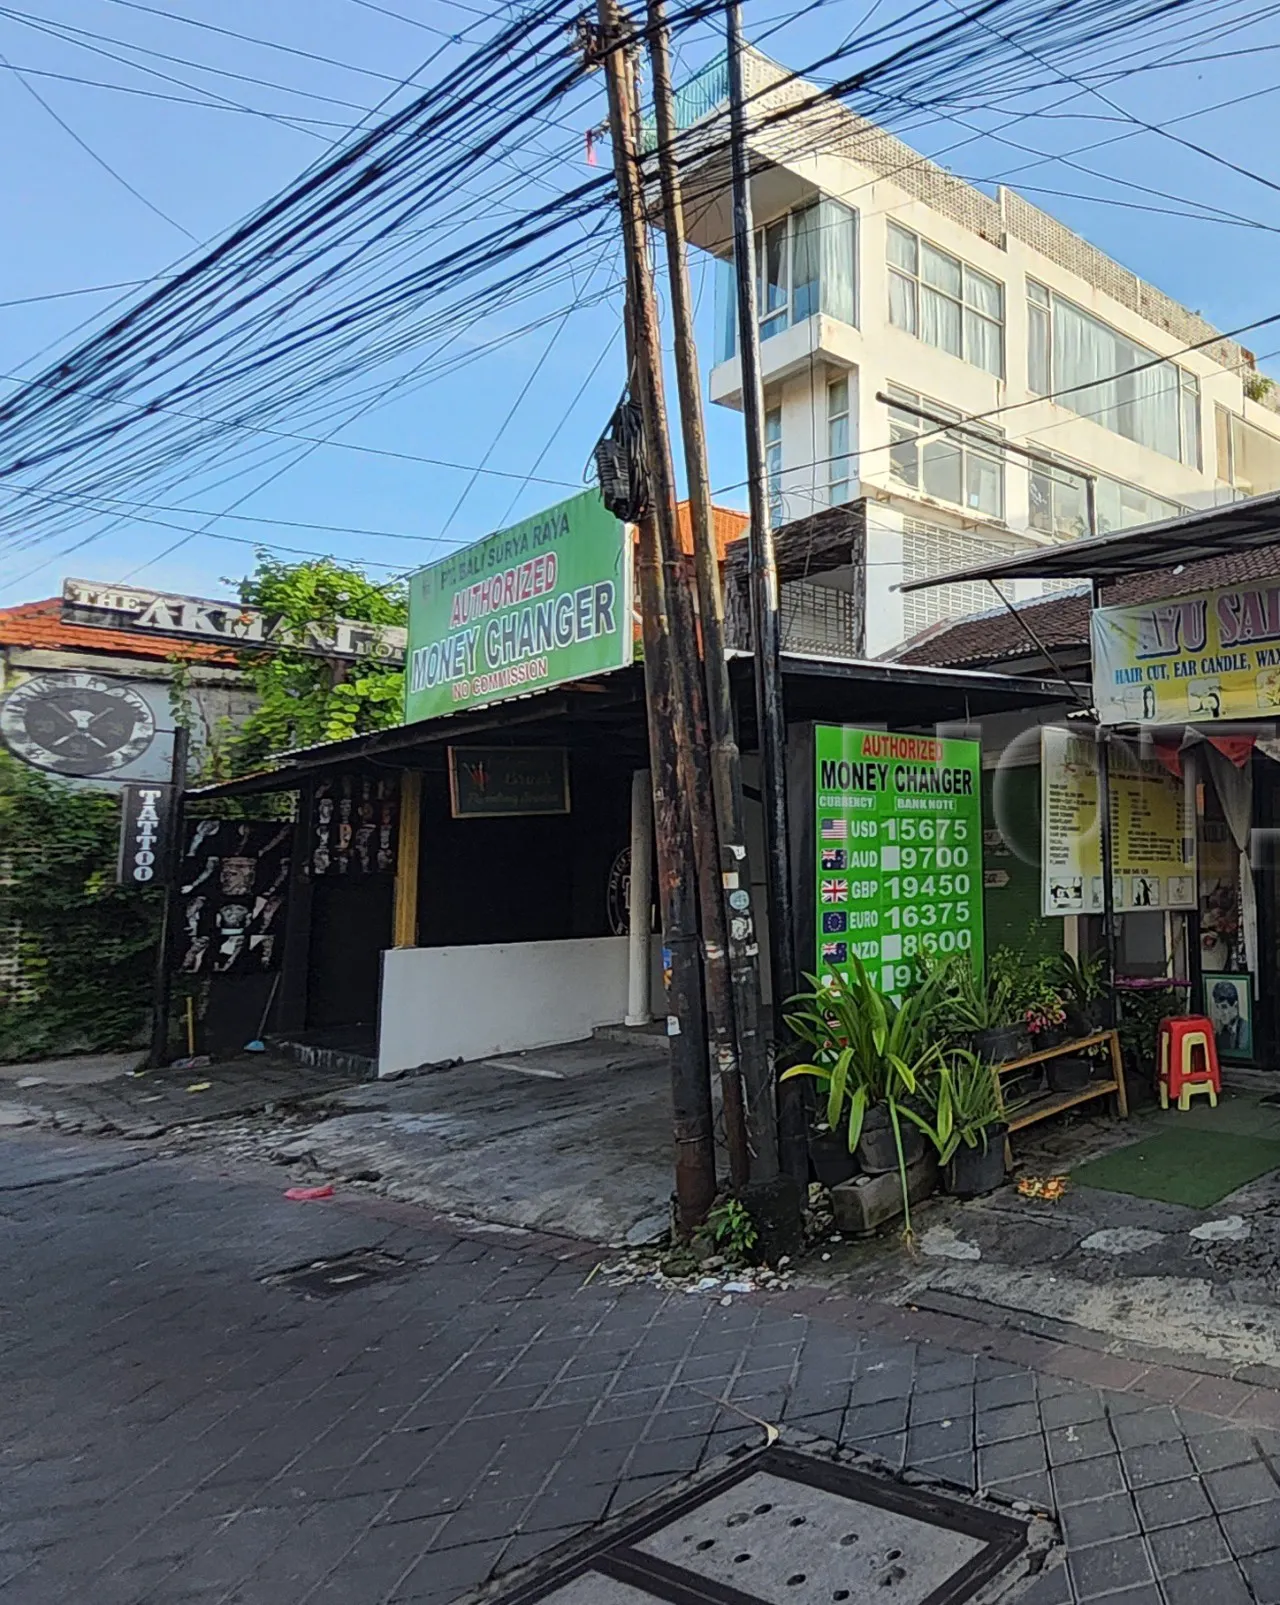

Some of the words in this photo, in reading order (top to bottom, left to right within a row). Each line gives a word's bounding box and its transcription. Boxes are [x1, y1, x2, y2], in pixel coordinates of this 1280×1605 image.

[460, 553, 486, 581] BALI
[487, 533, 529, 569] SURYA
[532, 511, 570, 549] RAYA
[74, 587, 145, 613] THE
[449, 551, 558, 630] AUTHORIZED
[411, 625, 481, 694] MONEY
[484, 579, 616, 669] CHANGER
[1136, 599, 1208, 660] AYU
[452, 680, 470, 702] NO
[471, 656, 548, 697] COMMISSION
[1115, 667, 1143, 685] HAIR
[1147, 663, 1170, 681] CUT,
[1173, 660, 1197, 678] EAR
[1201, 651, 1251, 674] CANDLE,
[861, 735, 944, 762] AUTHORIZED
[821, 760, 888, 792] MONEY
[894, 765, 973, 796] CHANGER
[818, 796, 874, 809] CURRENCY
[897, 797, 927, 810] BANK
[928, 798, 954, 811] NOTE
[133, 789, 161, 882] TATTOO
[851, 820, 877, 838] USD
[882, 817, 967, 841] 15675
[851, 850, 878, 868] AUD
[902, 846, 969, 870] 9700
[851, 880, 878, 899] GBP
[884, 874, 970, 900] 19450
[850, 910, 878, 930] EURO
[884, 901, 970, 930] 16375
[852, 940, 879, 960] NZD
[903, 929, 971, 957] 8600
